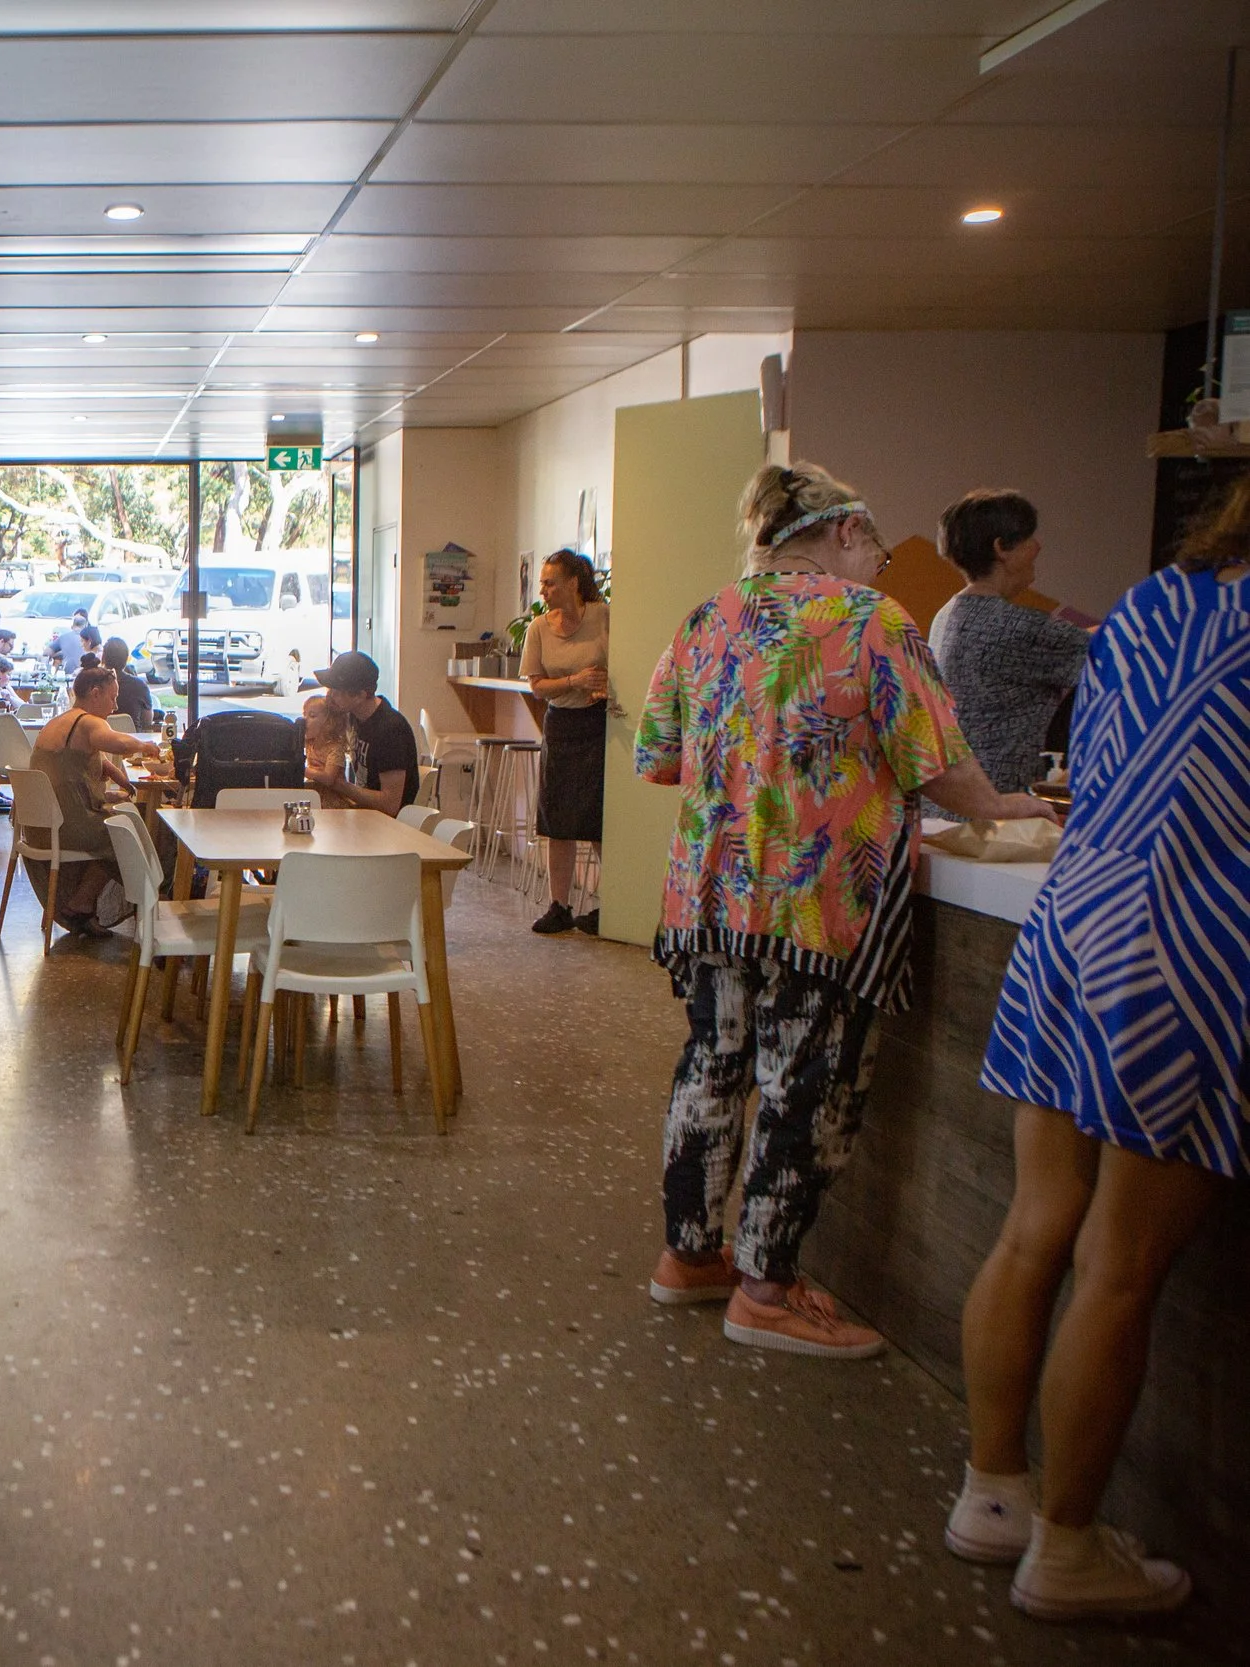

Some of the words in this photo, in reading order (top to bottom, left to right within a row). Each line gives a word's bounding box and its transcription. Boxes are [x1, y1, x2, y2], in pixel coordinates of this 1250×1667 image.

[41, 672, 47, 680] 2
[166, 726, 174, 737] 6
[300, 819, 310, 831] 11
